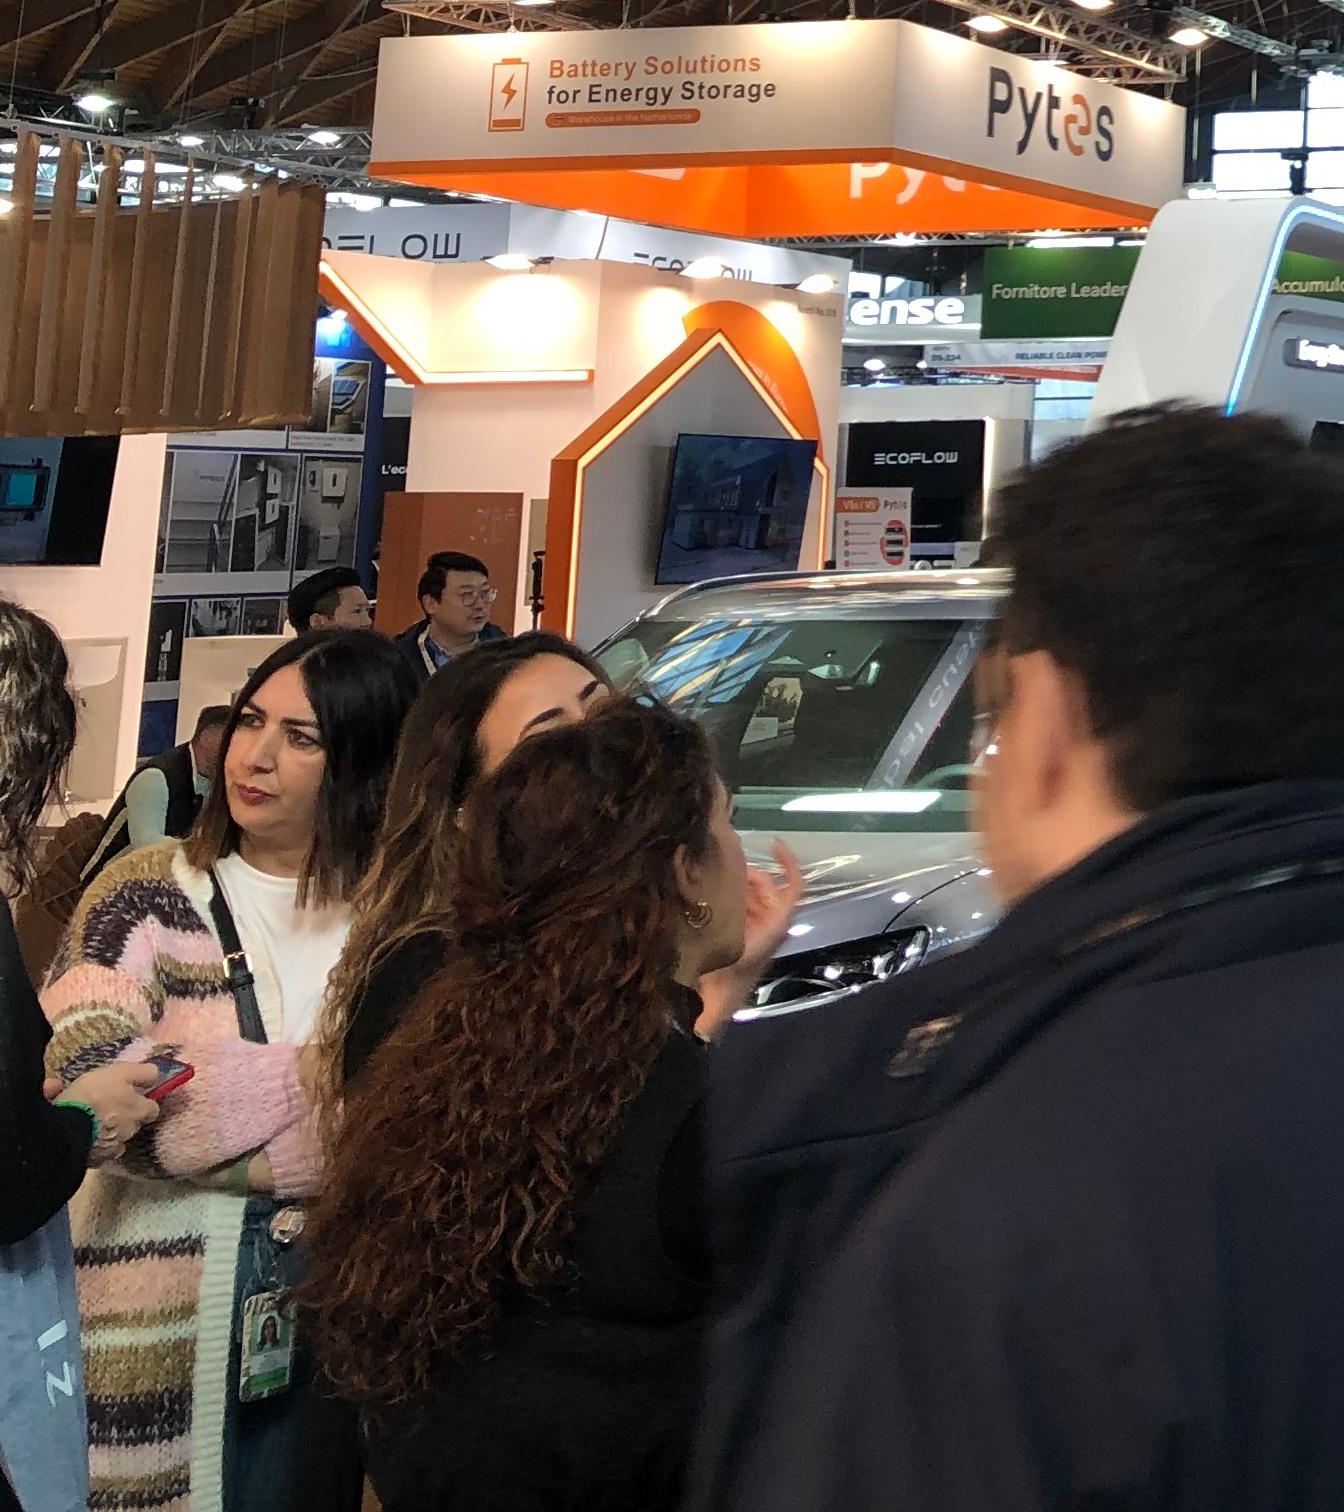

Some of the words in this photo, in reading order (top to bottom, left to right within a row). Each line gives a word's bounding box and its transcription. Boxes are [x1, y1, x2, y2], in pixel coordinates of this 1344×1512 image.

[549, 59, 636, 81] Battery
[644, 54, 761, 76] Solutions
[547, 85, 581, 105] for
[588, 84, 674, 106] Energy
[680, 80, 777, 103] Storage
[986, 66, 1114, 162] Pytes
[992, 284, 1066, 300] Fornitore
[1070, 283, 1128, 298] Leader
[1015, 352, 1054, 360] RELIABLE
[873, 451, 959, 466] ECOFLOW
